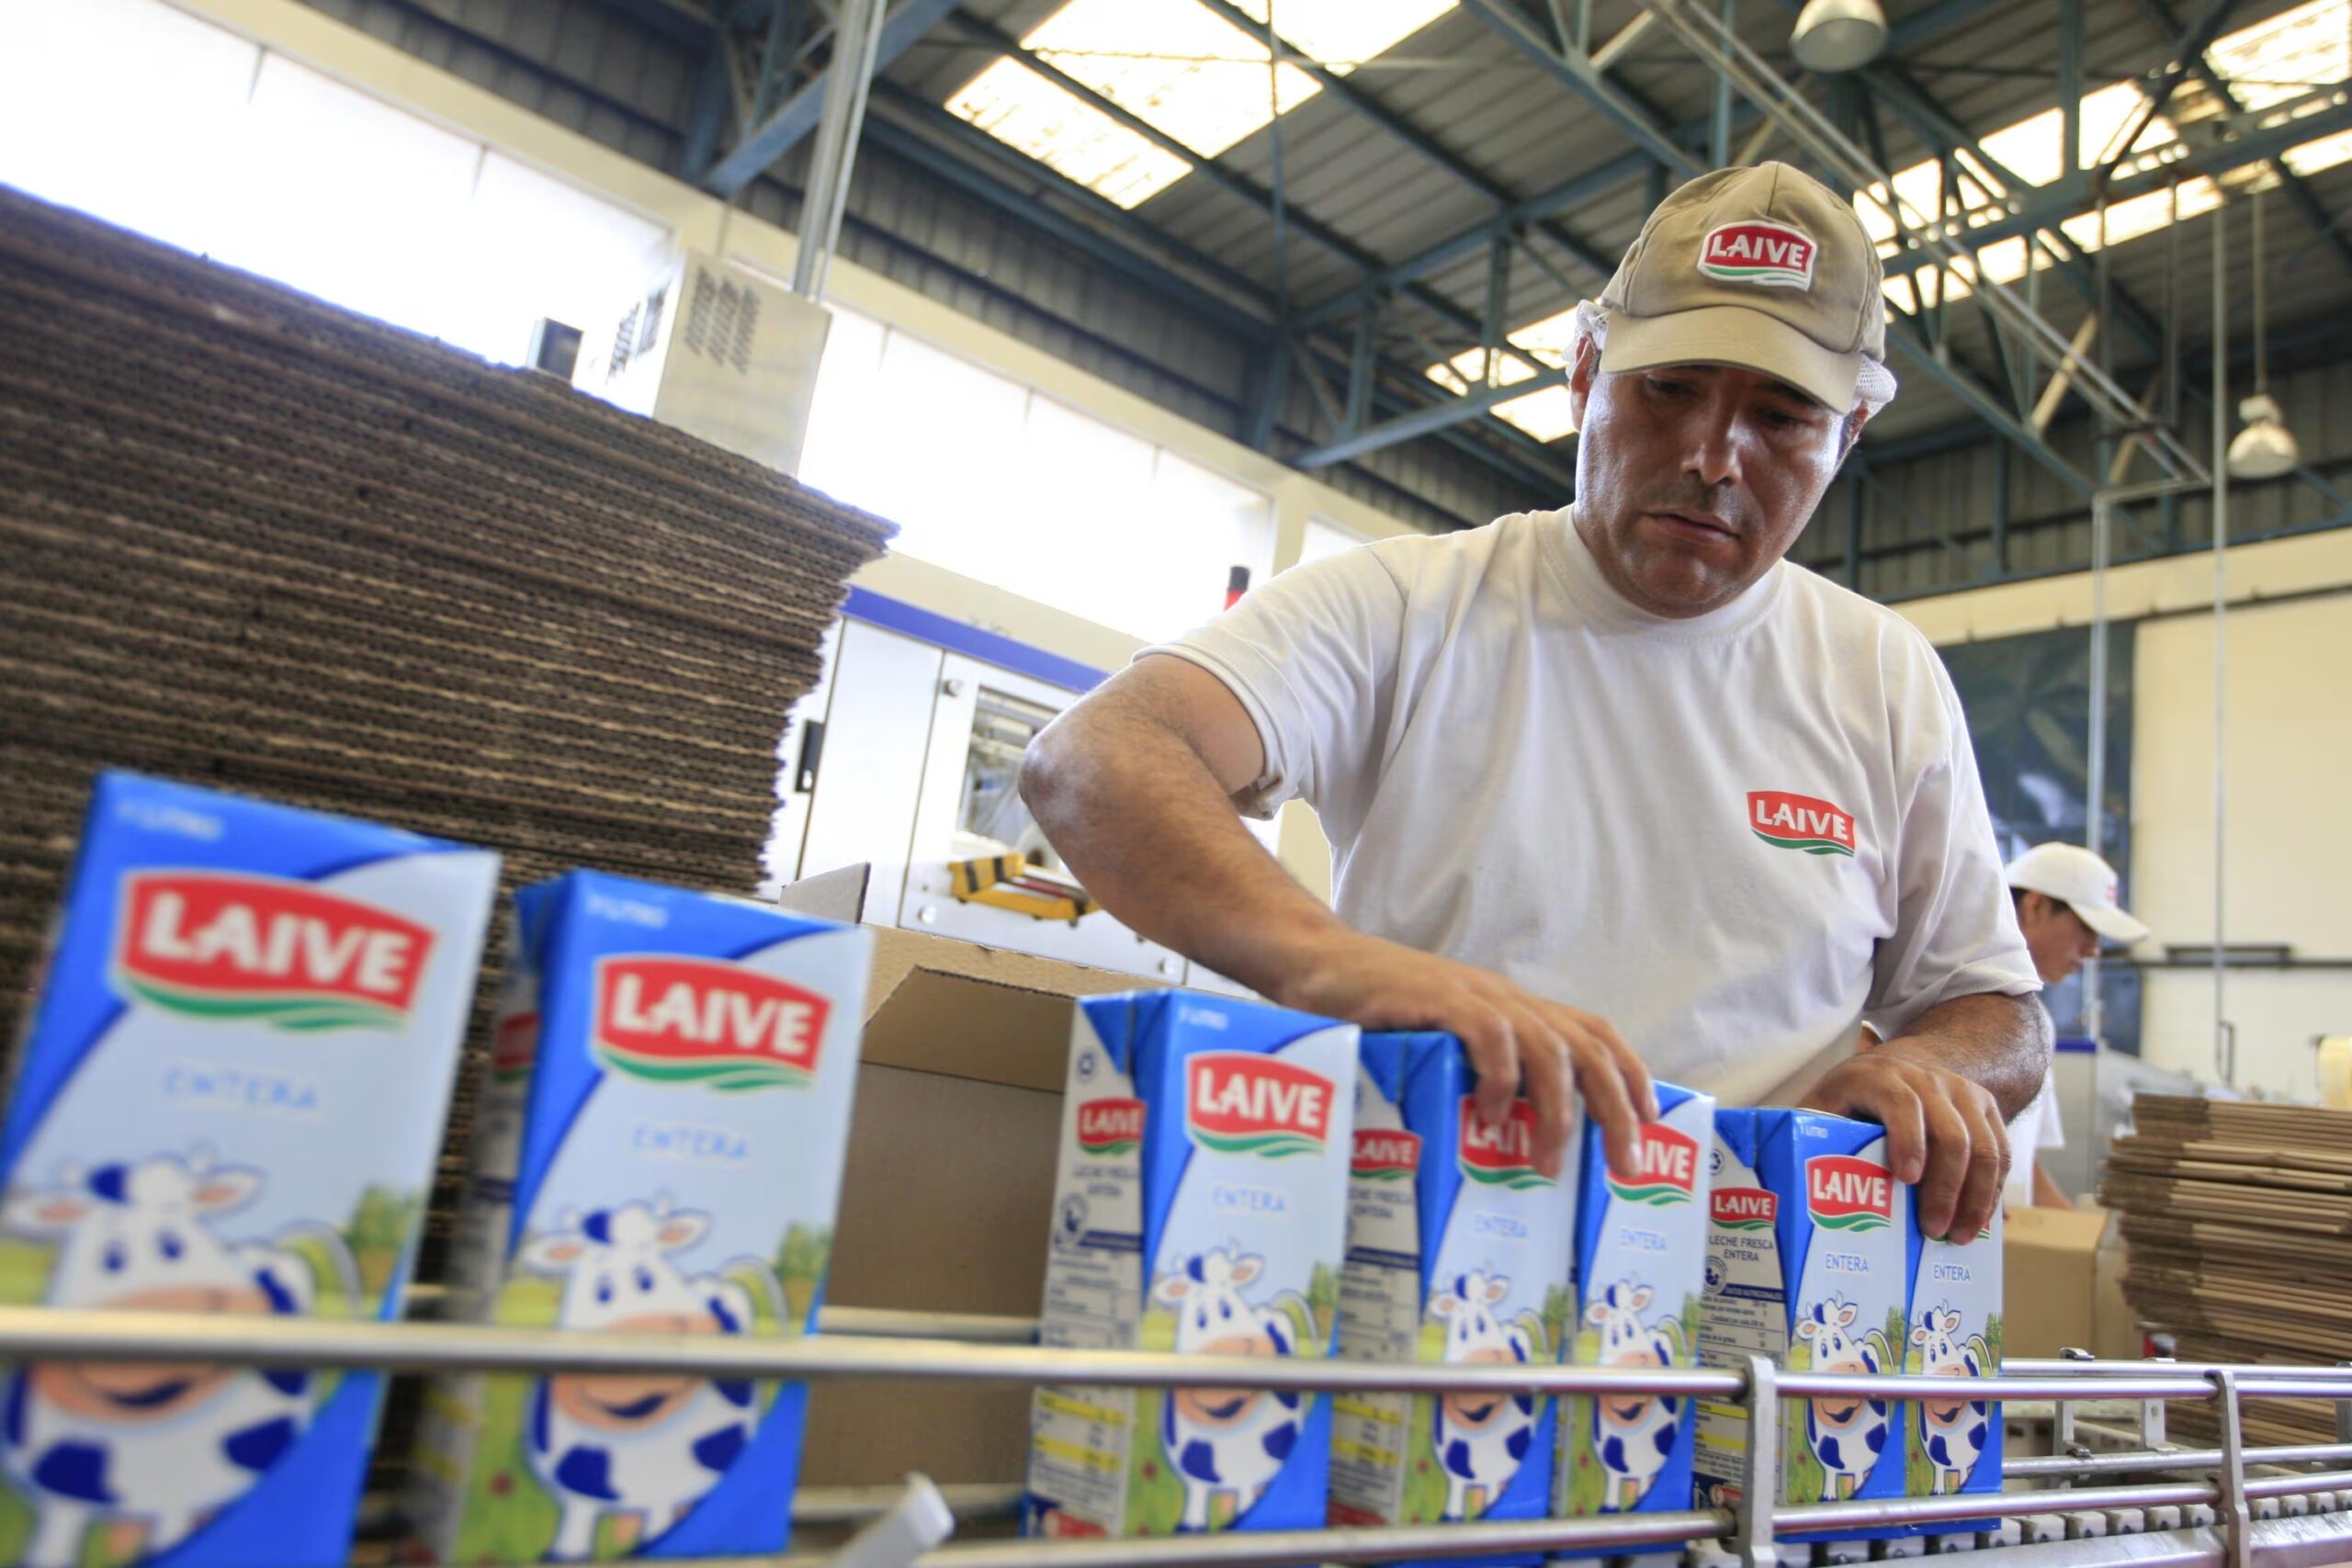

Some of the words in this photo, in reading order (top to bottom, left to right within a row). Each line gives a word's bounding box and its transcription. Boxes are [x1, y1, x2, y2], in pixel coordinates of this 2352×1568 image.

[1710, 234, 1805, 268] LAIVE
[1756, 799, 1849, 840] LAIVE
[142, 889, 411, 994] LAIVE
[611, 972, 814, 1056] LAIVE
[1196, 1066, 1323, 1127] LAIVE
[1082, 1108, 1141, 1134] LAIVE
[630, 1127, 750, 1159] ENTERA
[1212, 1186, 1285, 1213] ENTERA
[1812, 1168, 1887, 1208] LAIVE
[1713, 1194, 1771, 1216] LAIVE
[1709, 1235, 1738, 1247] LECHE
[1740, 1236, 1774, 1250] FRESCA
[1724, 1248, 1759, 1262] ENTERA
[1825, 1253, 1869, 1272] ENTERA
[1933, 1264, 1971, 1281] ENTERA
